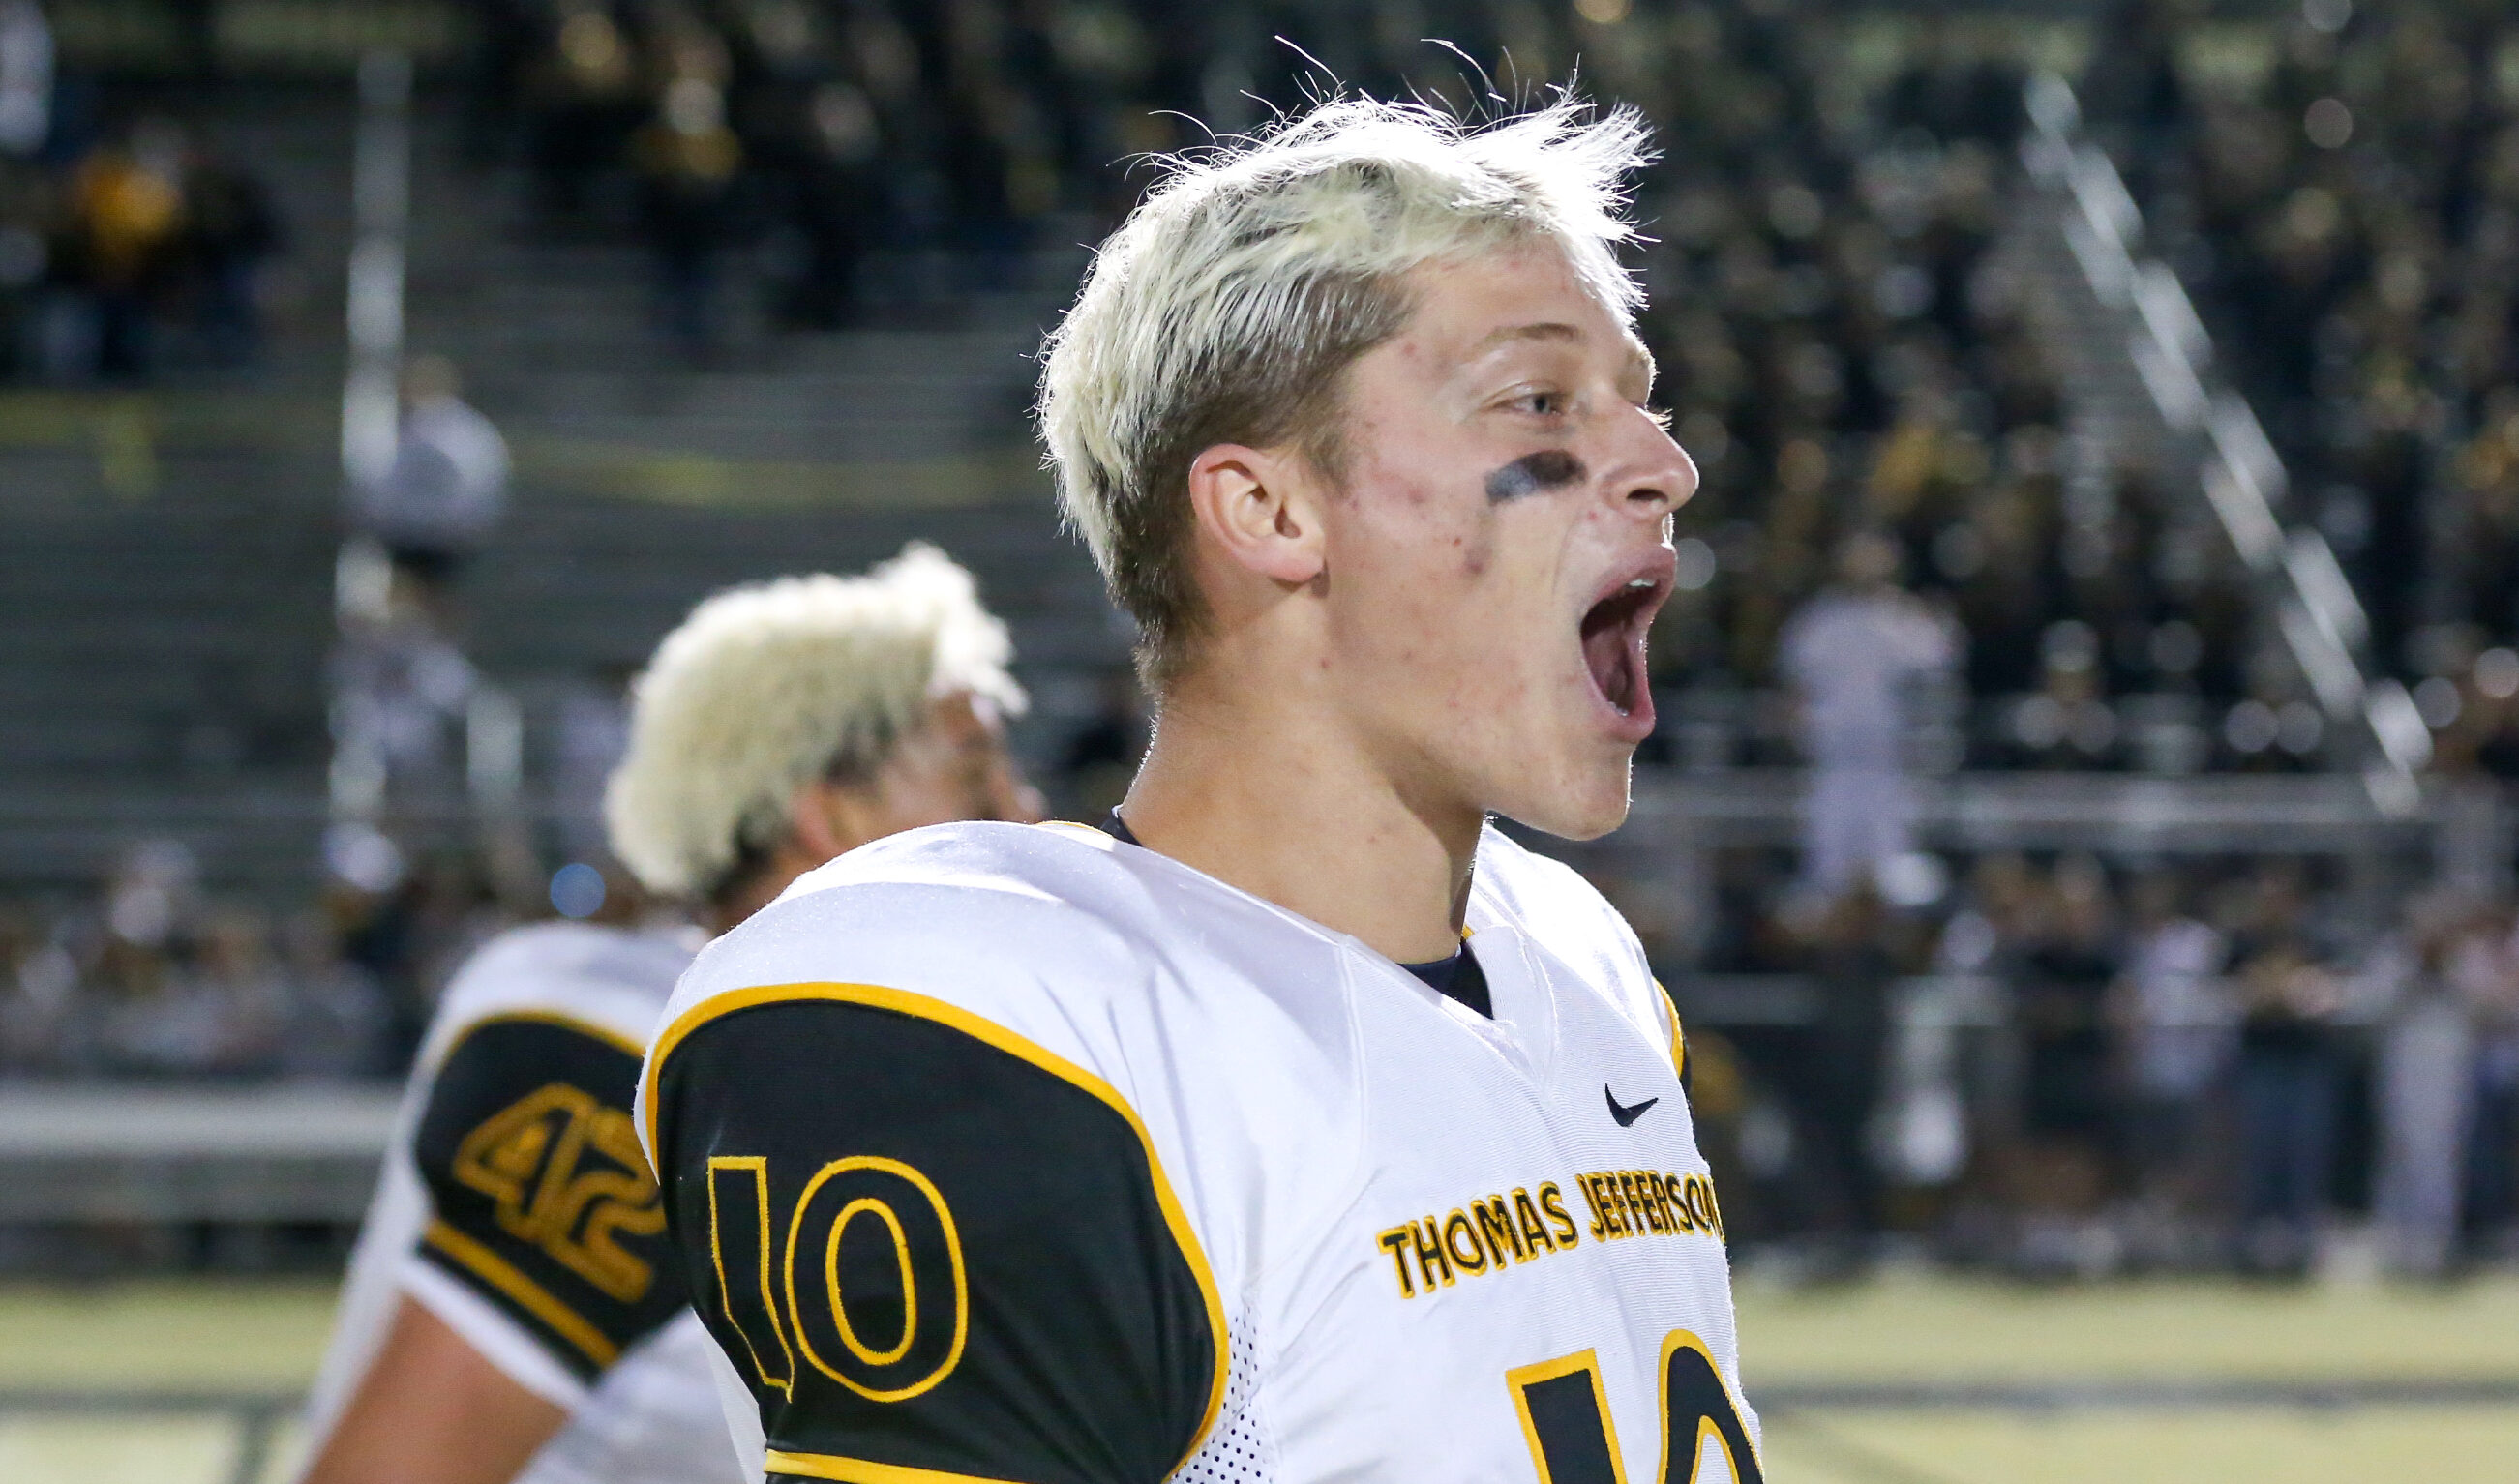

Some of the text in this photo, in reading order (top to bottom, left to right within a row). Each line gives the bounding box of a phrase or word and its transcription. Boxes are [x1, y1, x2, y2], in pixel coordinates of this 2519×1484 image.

[455, 1083, 666, 1303] 42
[707, 1155, 968, 1403] 10
[1376, 1181, 1579, 1298] THOMAS
